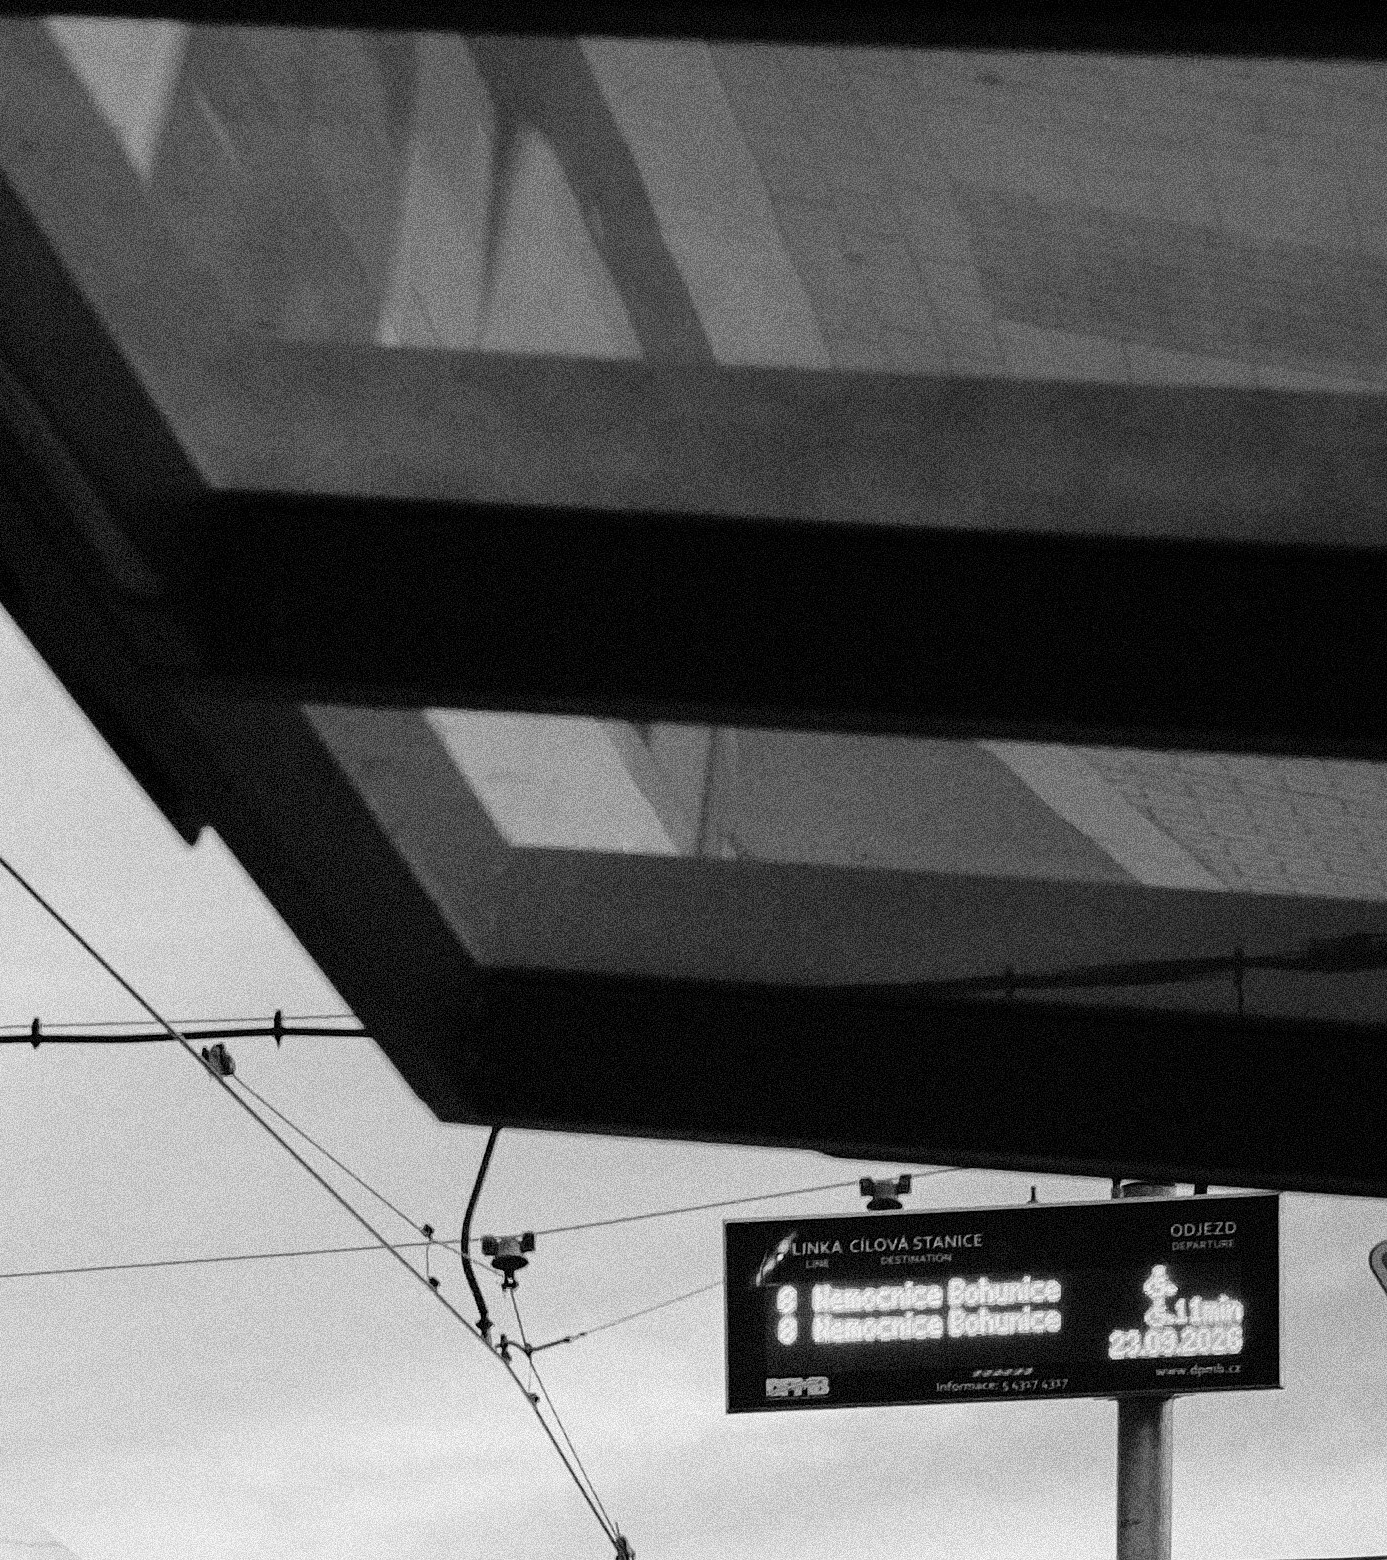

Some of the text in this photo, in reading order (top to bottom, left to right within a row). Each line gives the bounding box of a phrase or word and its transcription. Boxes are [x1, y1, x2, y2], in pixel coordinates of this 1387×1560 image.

[1170, 1221, 1237, 1238] ODJEZD
[791, 1233, 983, 1256] LINKA CÍLOVÁ STANICE
[1172, 1239, 1235, 1251] DEPARTURE
[880, 1252, 953, 1266] DESTINATION
[812, 1282, 944, 1314] Nemocnice
[947, 1277, 1061, 1308] Bohunice
[812, 1311, 944, 1343] Nemocnice
[947, 1305, 1061, 1338] Bohunice
